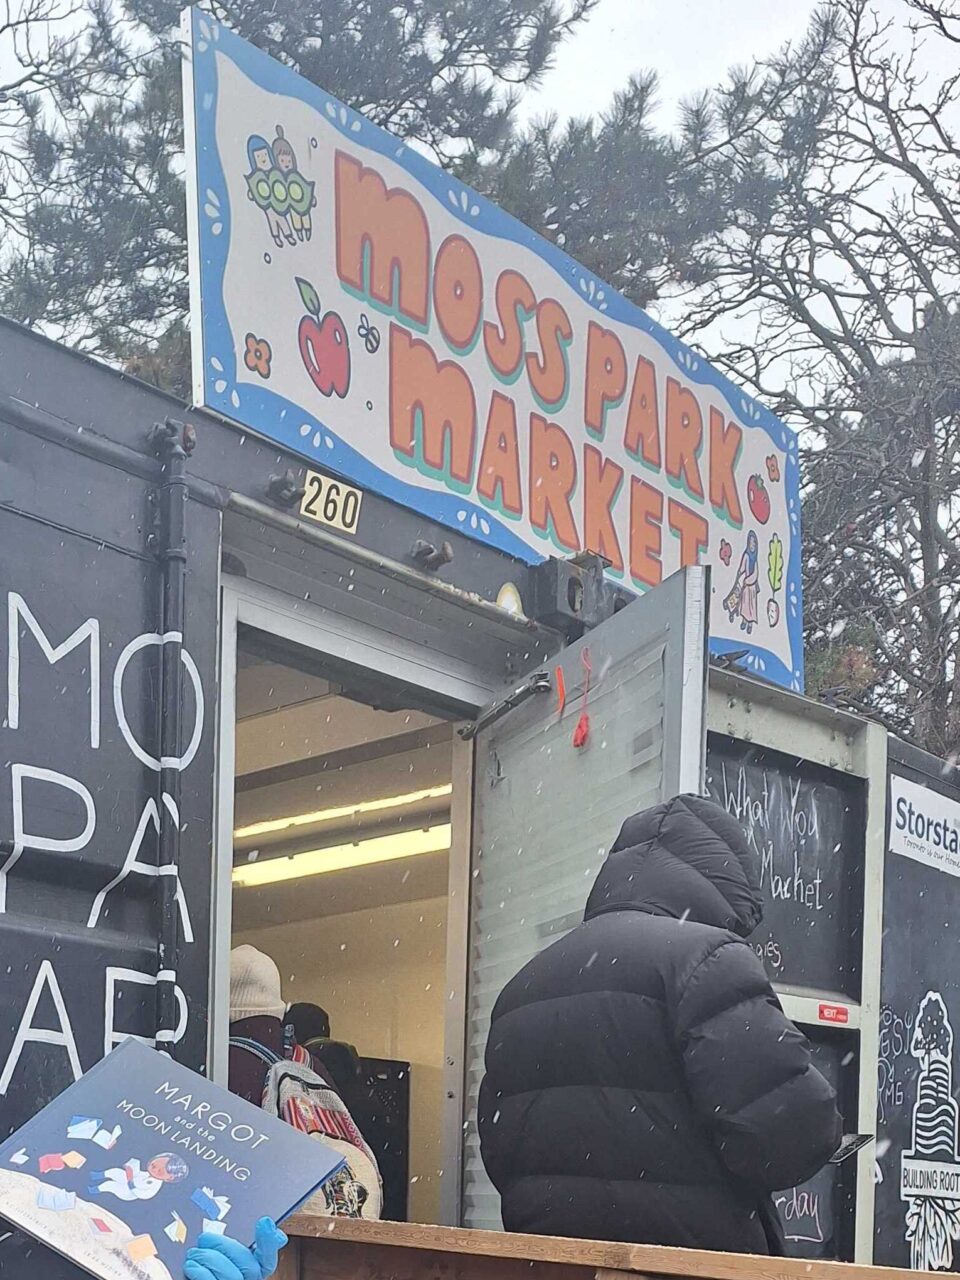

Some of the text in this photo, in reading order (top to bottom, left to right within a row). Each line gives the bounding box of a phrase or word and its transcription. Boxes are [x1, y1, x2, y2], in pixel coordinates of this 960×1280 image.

[335, 149, 743, 530] MOSS PARK
[389, 322, 709, 585] MARKET
[304, 476, 359, 528] 260
[8, 591, 205, 772] MO
[722, 762, 770, 830] What
[760, 841, 823, 910] Market
[116, 1099, 252, 1182] MOON LANDING
[155, 1081, 270, 1149] MARGOT
[174, 1115, 216, 1142] and the
[903, 1167, 938, 1190] BUILDING
